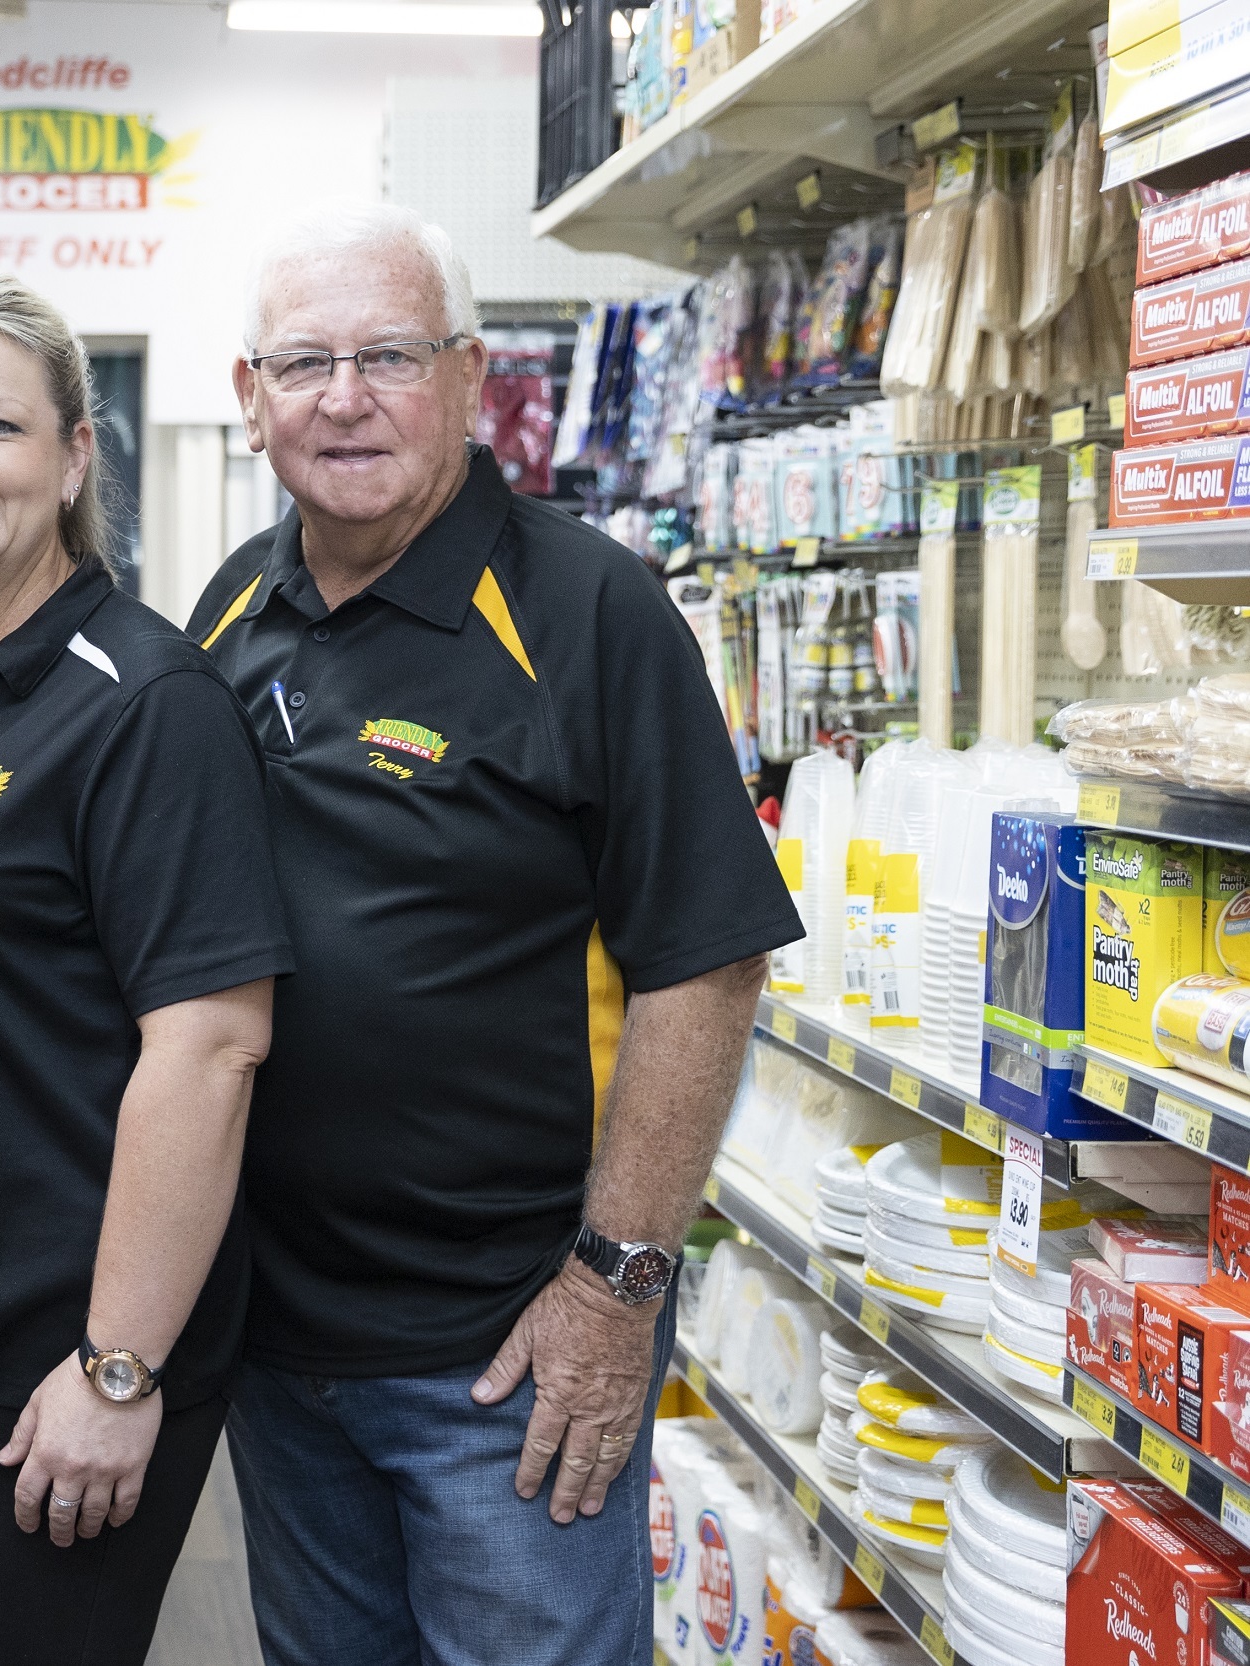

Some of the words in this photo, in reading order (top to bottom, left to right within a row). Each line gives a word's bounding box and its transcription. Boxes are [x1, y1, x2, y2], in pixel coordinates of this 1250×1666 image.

[1152, 211, 1194, 247] Multix
[1199, 202, 1248, 245] ALFOIL
[52, 235, 163, 269] ONLY
[1145, 296, 1188, 329] Multix
[1193, 291, 1242, 331] ALFOIL
[1192, 360, 1212, 375] STRONG
[1138, 380, 1180, 411] Multix
[1186, 380, 1234, 416] ALFOIL
[1180, 447, 1202, 460] STRONG
[1124, 463, 1168, 493] Multix
[1174, 468, 1225, 502] ALFOIL
[372, 734, 431, 758] GROCER
[374, 719, 442, 751] FRIENDLY
[368, 752, 414, 780] Terry
[1093, 852, 1139, 880] EnviroSafe
[1161, 869, 1189, 881] Pantry
[1220, 873, 1248, 885] Pantry
[997, 863, 1029, 903] Deeko
[1161, 878, 1187, 888] moth
[1138, 898, 1151, 916] x2
[1093, 926, 1134, 966] Pantry
[1093, 958, 1130, 990] moth
[1206, 1013, 1227, 1031] BASE
[1067, 1033, 1085, 1042] ENT
[1009, 1136, 1041, 1167] SPECIAL
[1222, 1211, 1249, 1232] MATCHES
[1097, 1288, 1134, 1321] Redhead
[1141, 1302, 1173, 1331] Redheads
[1146, 1334, 1169, 1356] MATCHES
[1178, 1387, 1185, 1399] 12
[1103, 1597, 1157, 1661] Redheads
